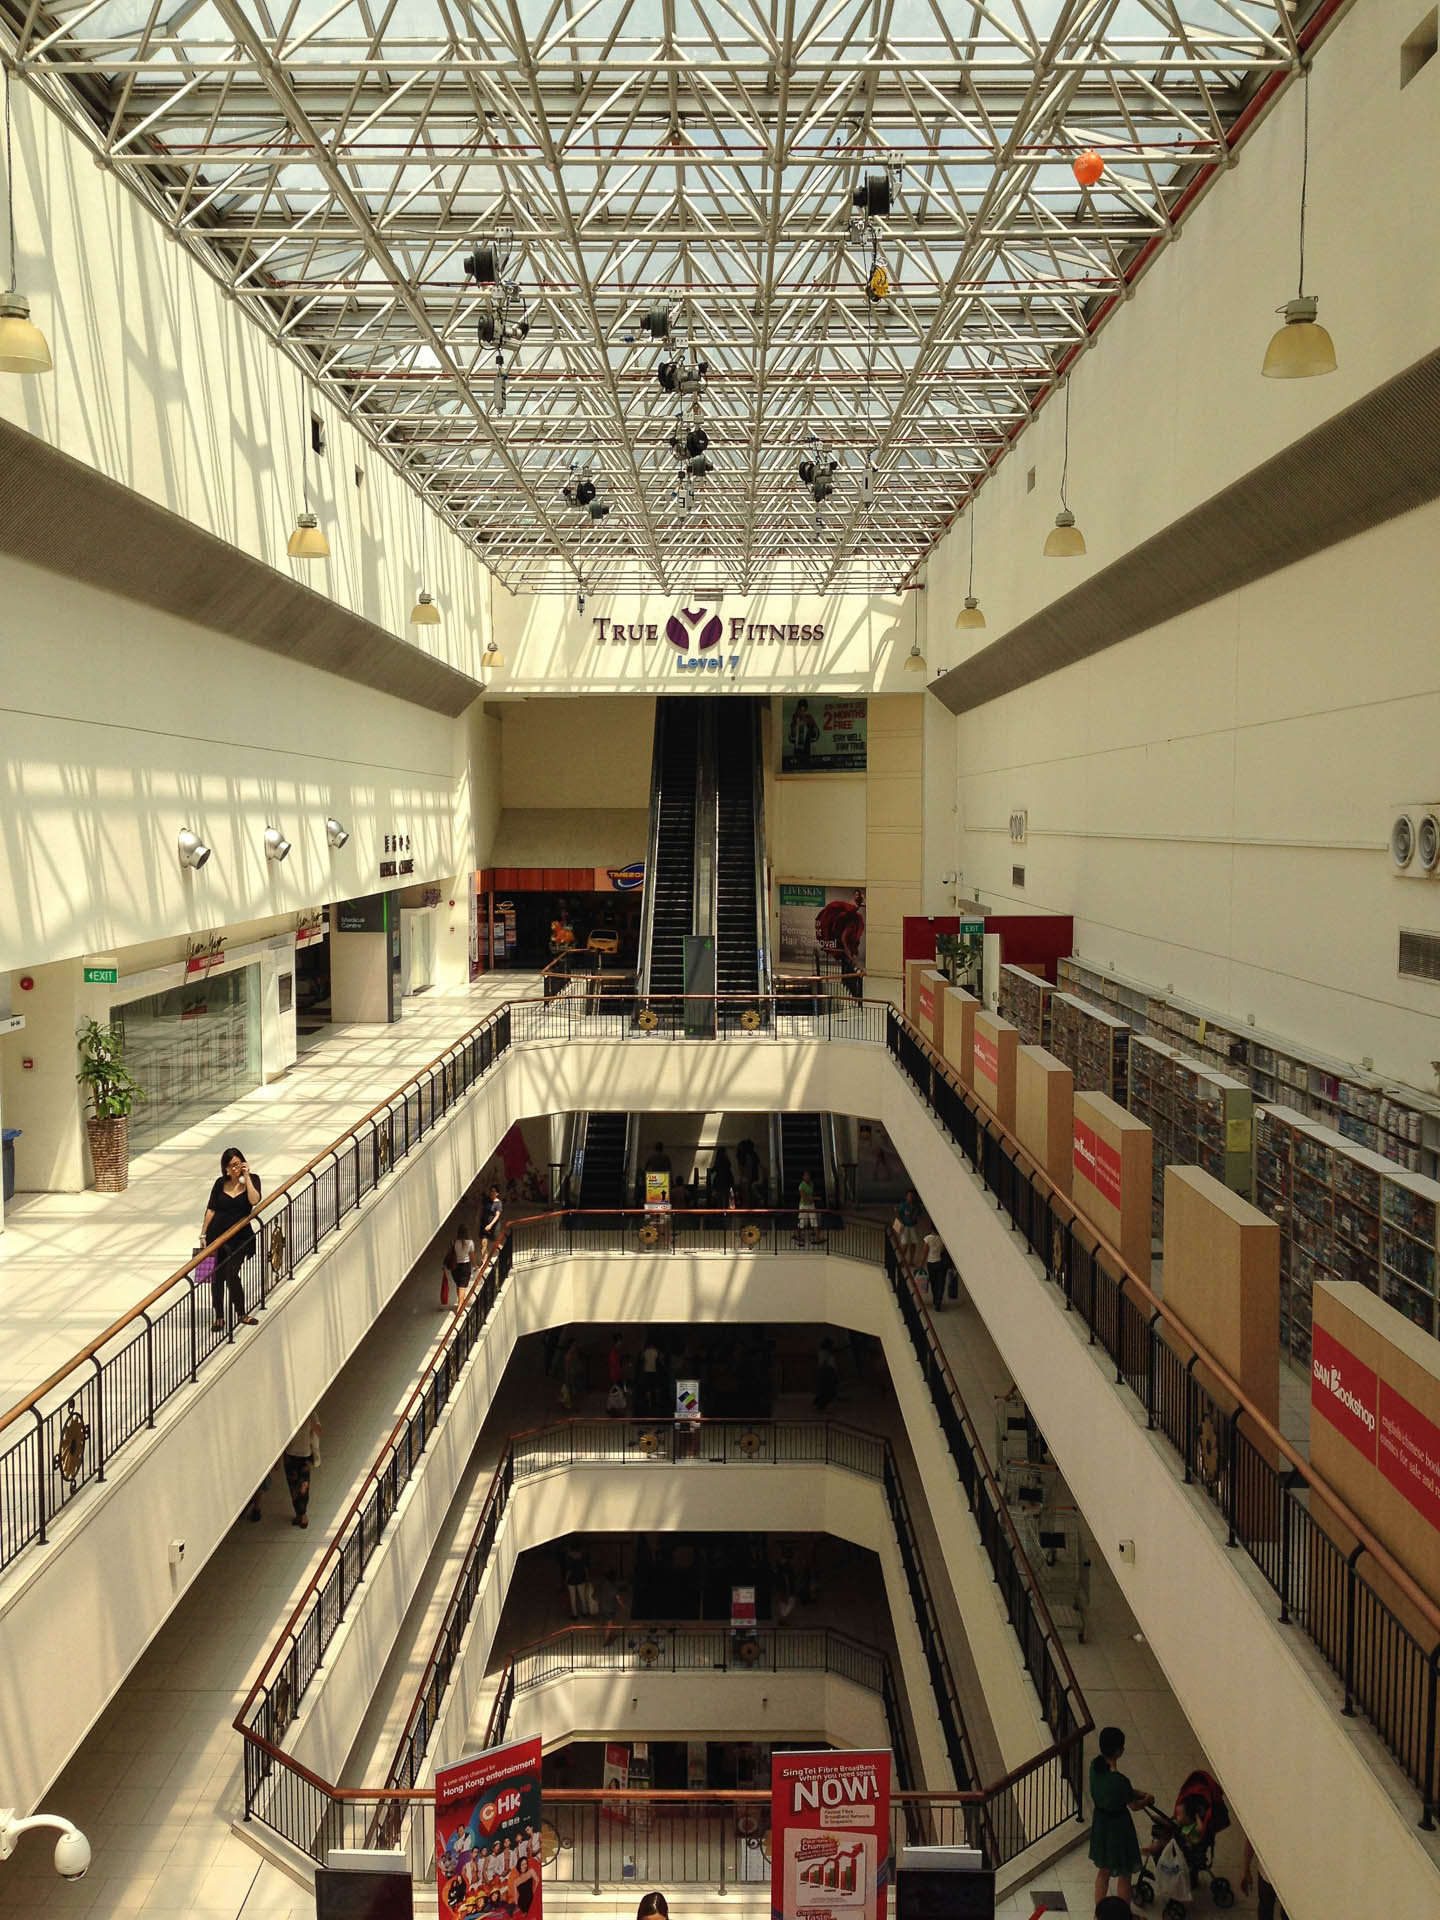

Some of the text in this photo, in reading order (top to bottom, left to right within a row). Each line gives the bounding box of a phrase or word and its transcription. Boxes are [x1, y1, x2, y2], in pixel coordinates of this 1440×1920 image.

[677, 655, 740, 669] Level 7
[824, 711, 833, 731] 2
[93, 971, 113, 981] EXIT
[443, 1757, 536, 1798] Hong Kong entertainment
[783, 1767, 817, 1777] SingTel
[818, 1766, 838, 1774] Fibre
[799, 1774, 822, 1782] when
[823, 1773, 837, 1781] you
[794, 1775, 880, 1812] NOW!
